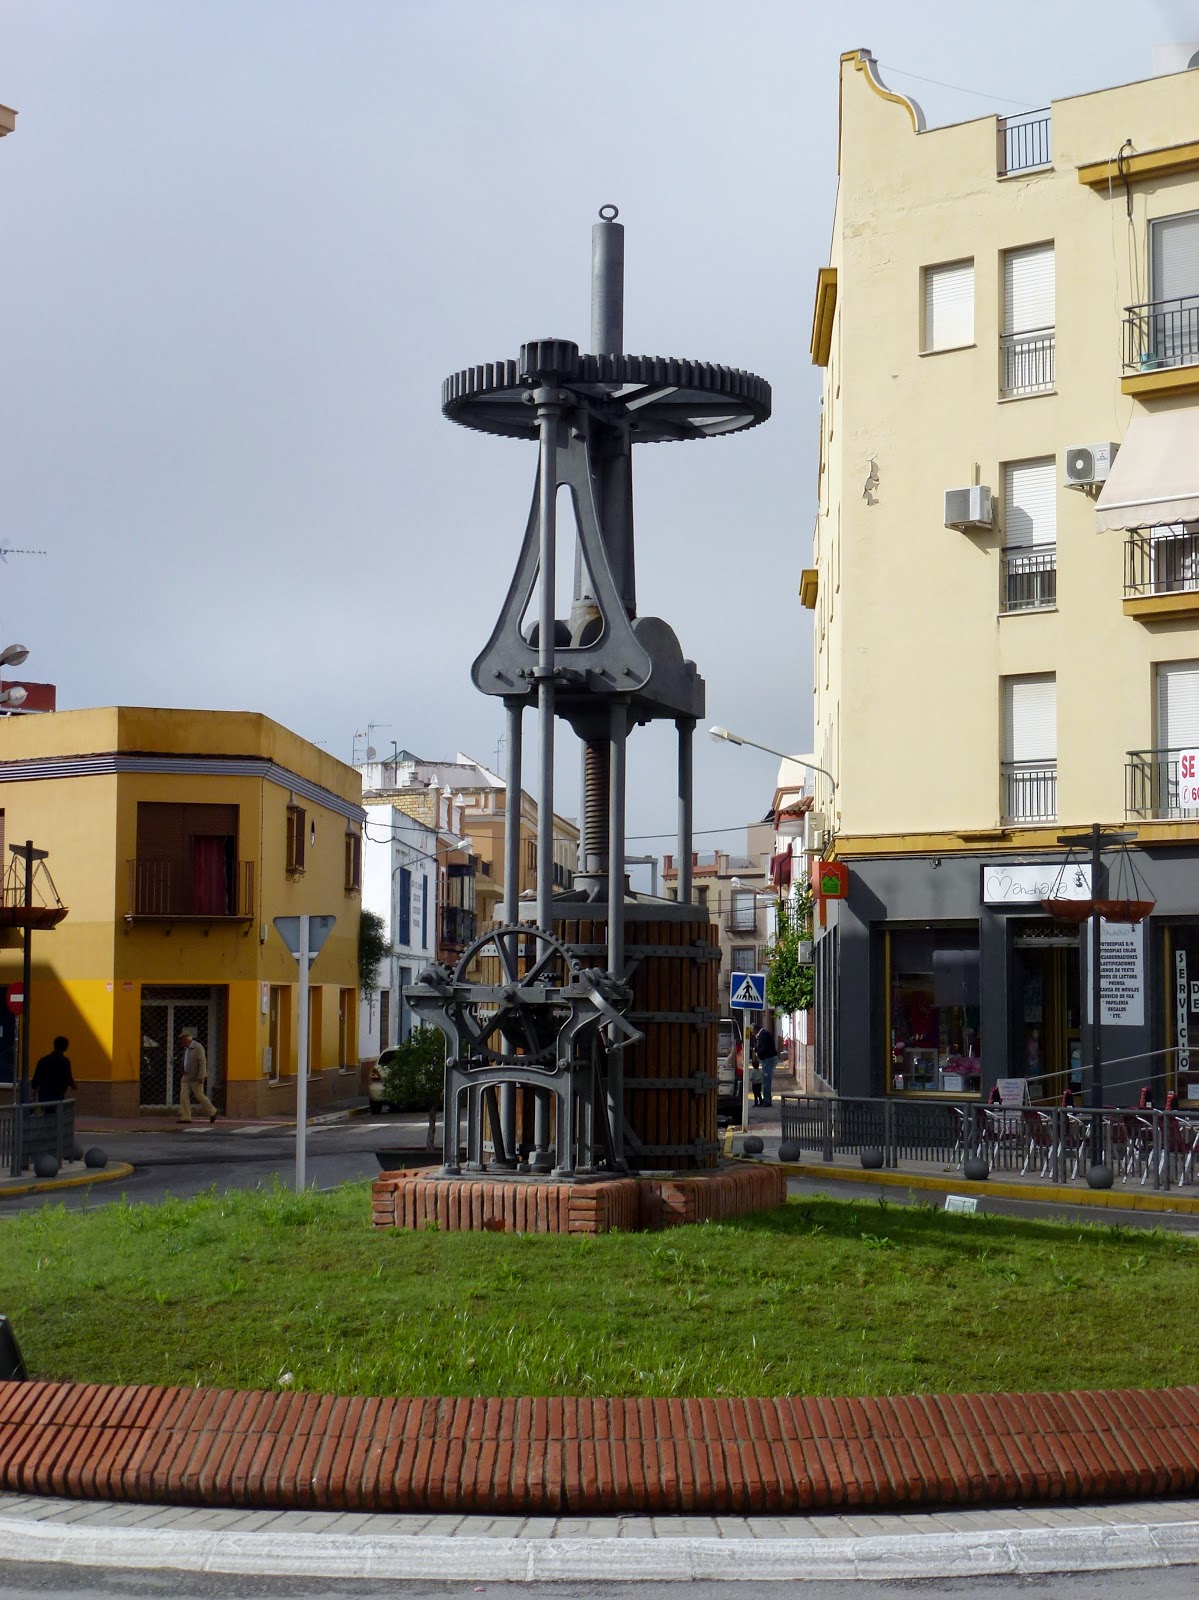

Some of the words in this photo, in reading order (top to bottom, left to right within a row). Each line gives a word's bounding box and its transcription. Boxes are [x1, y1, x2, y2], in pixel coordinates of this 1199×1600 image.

[1181, 755, 1195, 779] SE
[1191, 787, 1199, 801] 6
[1178, 952, 1189, 1068] SERVICIO
